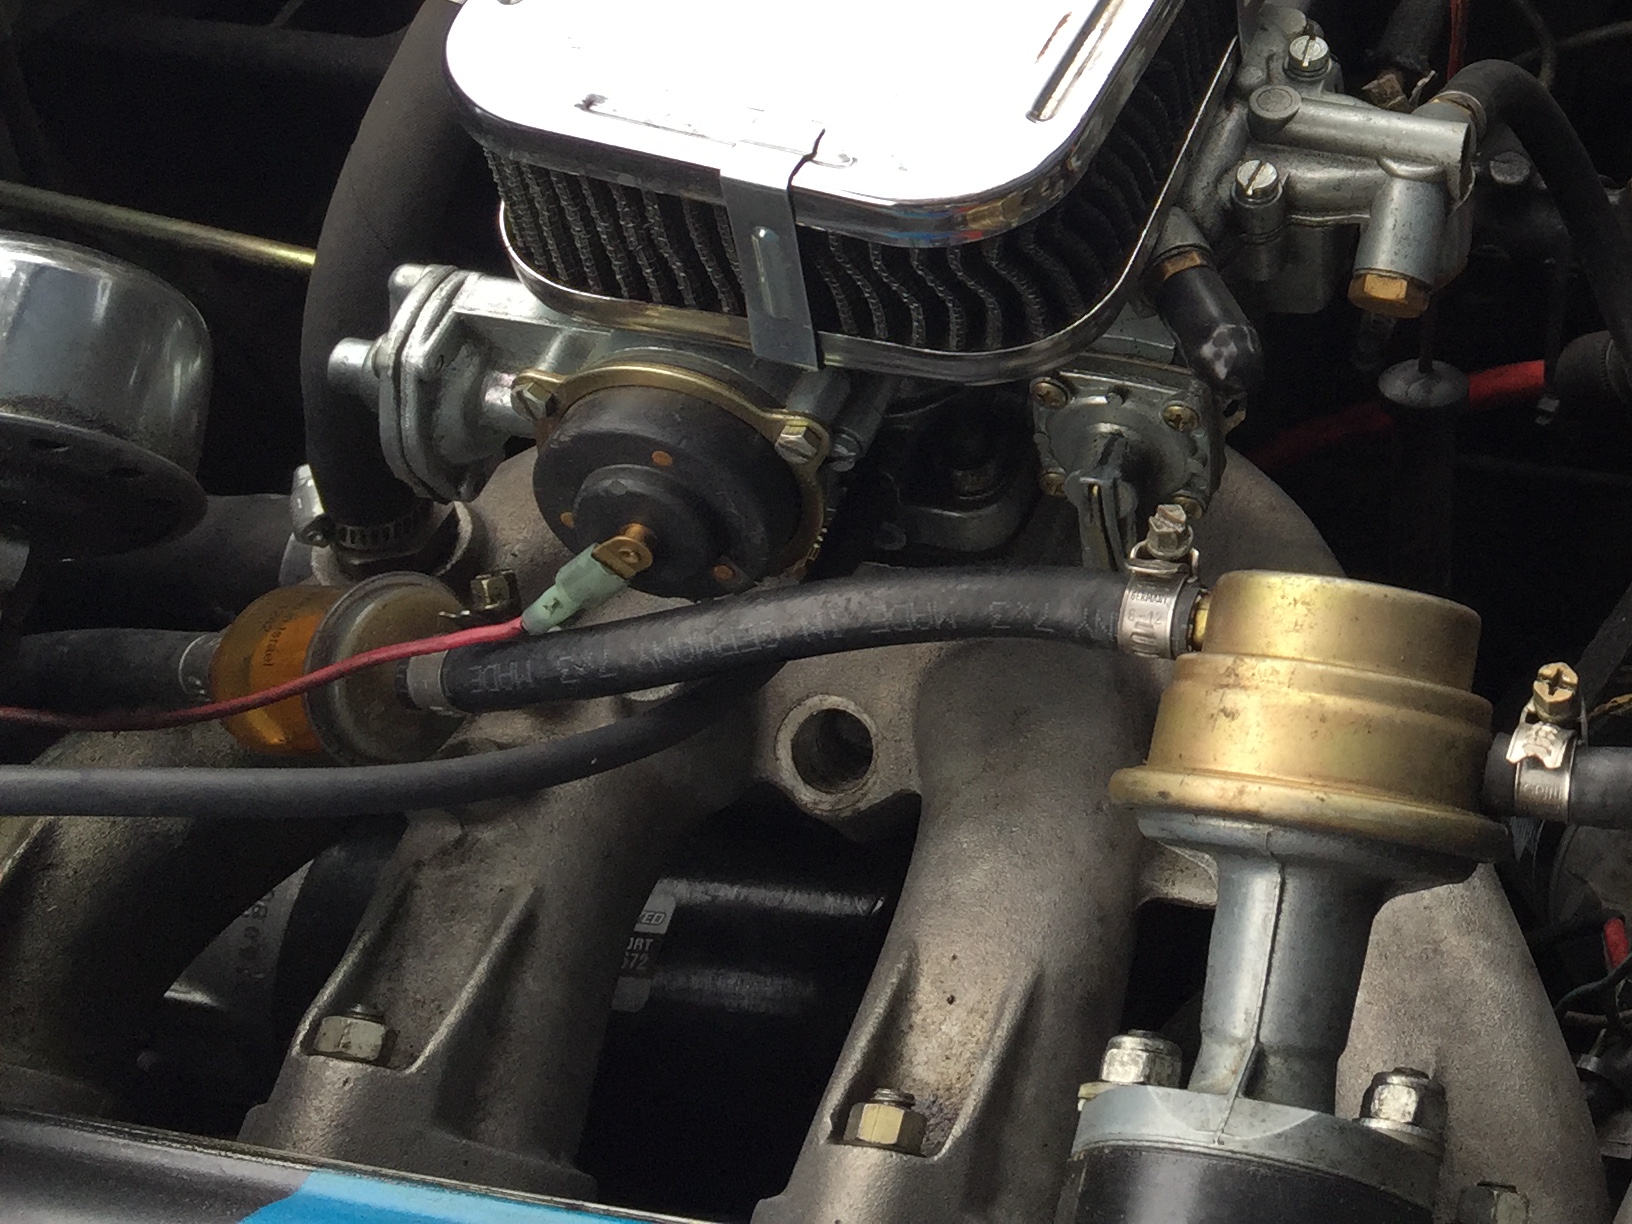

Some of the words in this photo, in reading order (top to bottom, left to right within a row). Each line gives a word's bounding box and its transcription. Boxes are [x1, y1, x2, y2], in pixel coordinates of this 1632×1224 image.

[865, 594, 958, 634] MADE
[1130, 592, 1168, 604] GERMANY
[466, 659, 534, 694] MADE
